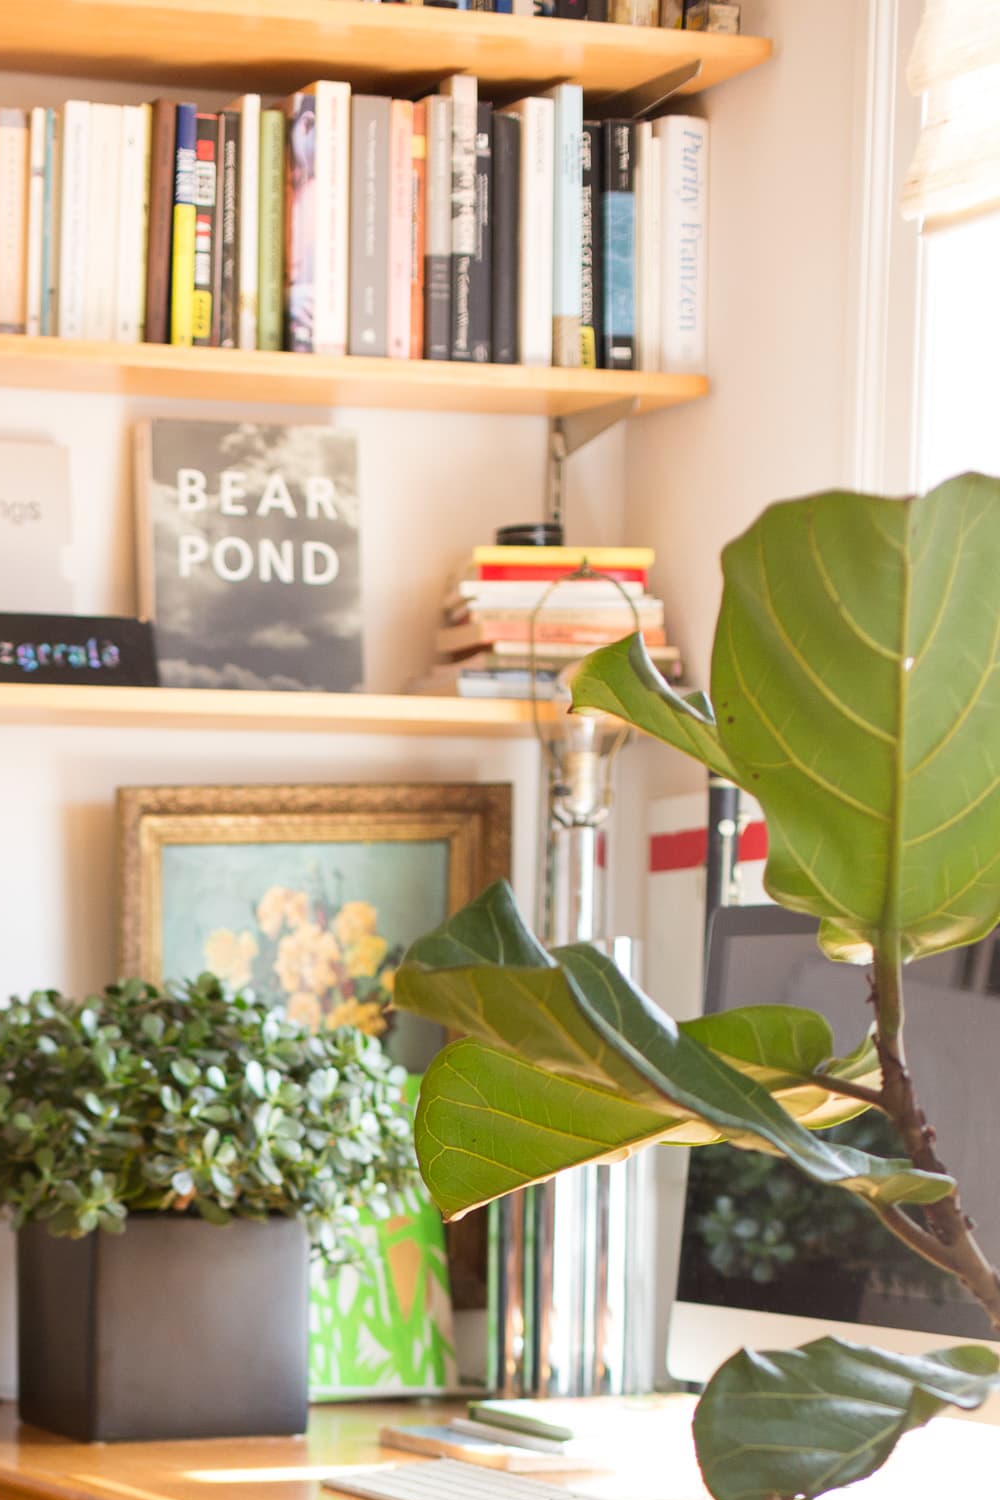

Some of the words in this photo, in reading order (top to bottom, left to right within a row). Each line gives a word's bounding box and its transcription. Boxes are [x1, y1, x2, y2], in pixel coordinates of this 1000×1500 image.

[674, 129, 704, 210] Purity
[679, 221, 703, 332] Franzen
[177, 467, 339, 521] BEAR
[177, 533, 341, 586] POND
